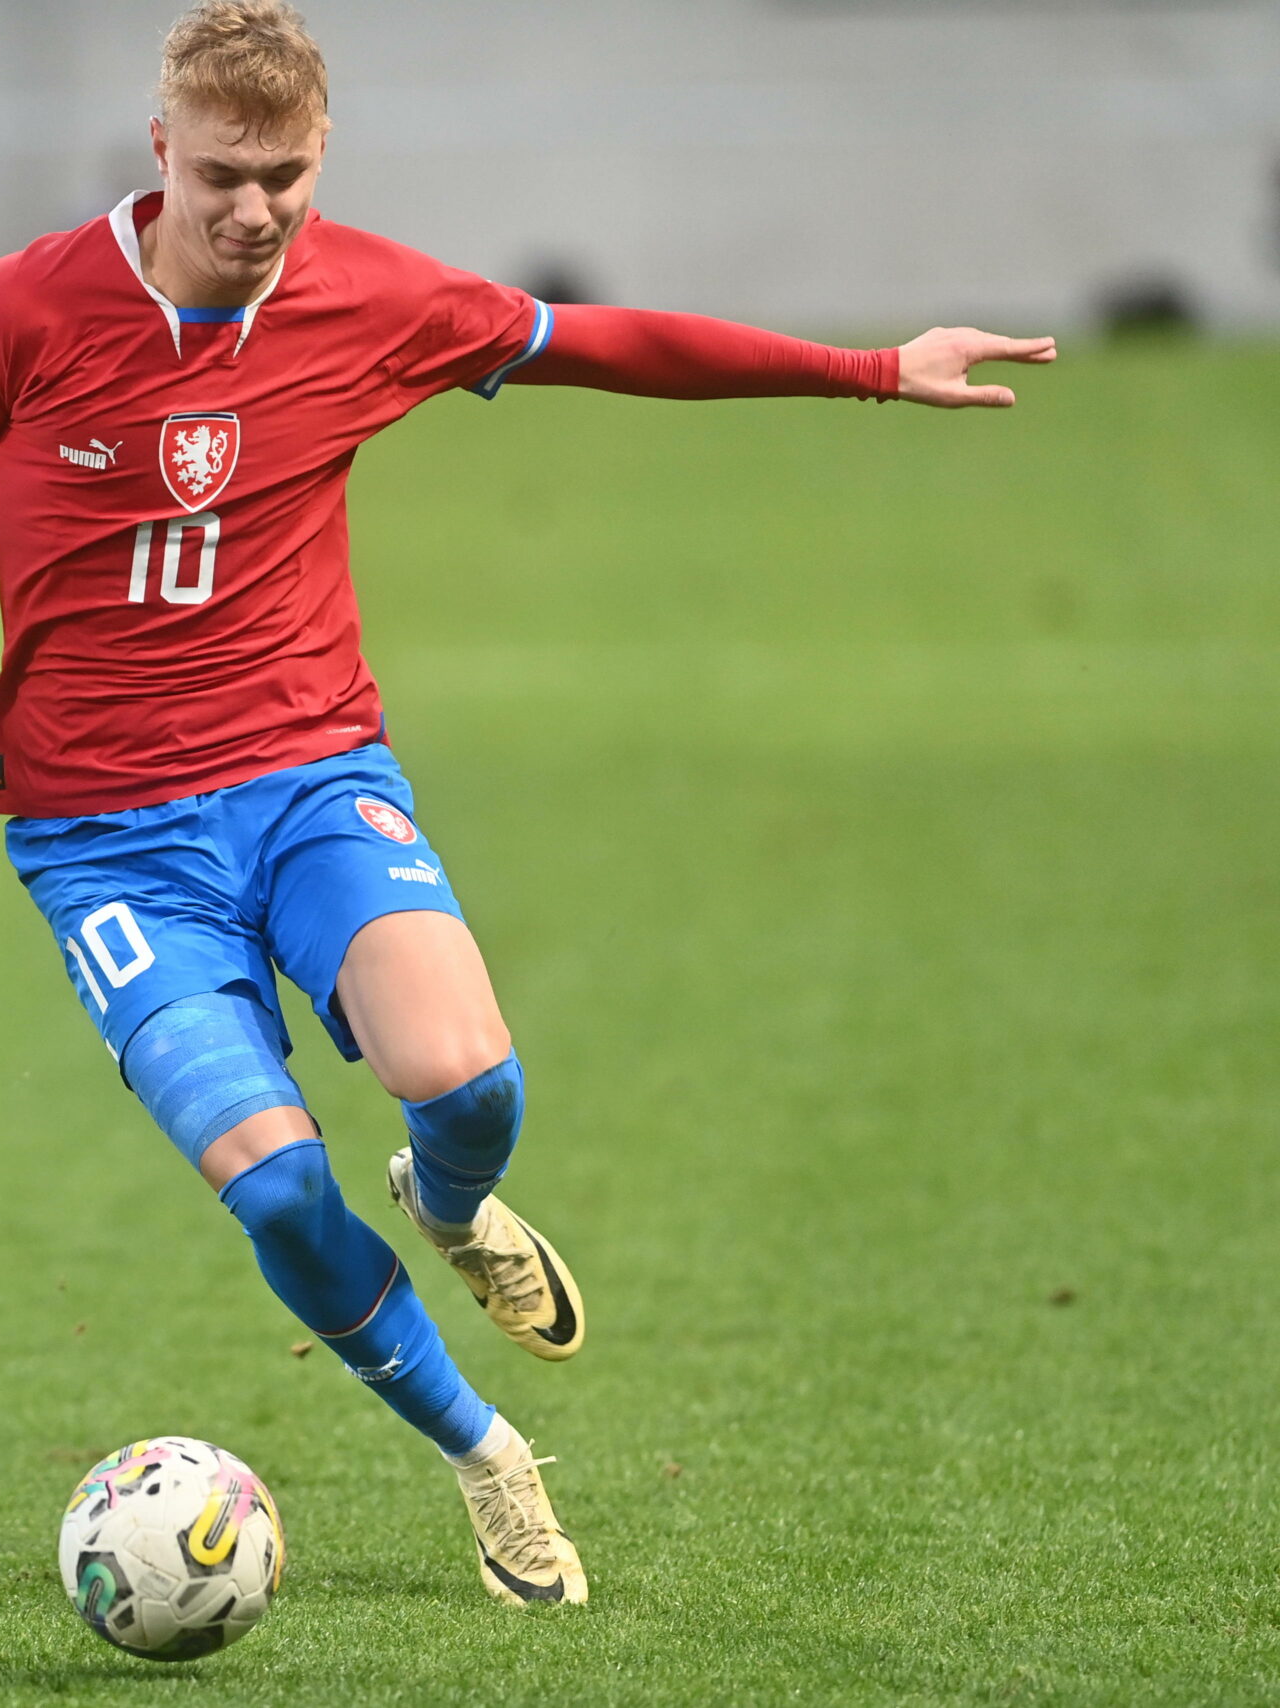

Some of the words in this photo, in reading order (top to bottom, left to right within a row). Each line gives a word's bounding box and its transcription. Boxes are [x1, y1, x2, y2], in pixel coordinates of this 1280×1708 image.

[60, 444, 106, 470] PUMA
[128, 511, 220, 605] 10
[388, 866, 437, 887] PUMA
[66, 902, 156, 1015] 10
